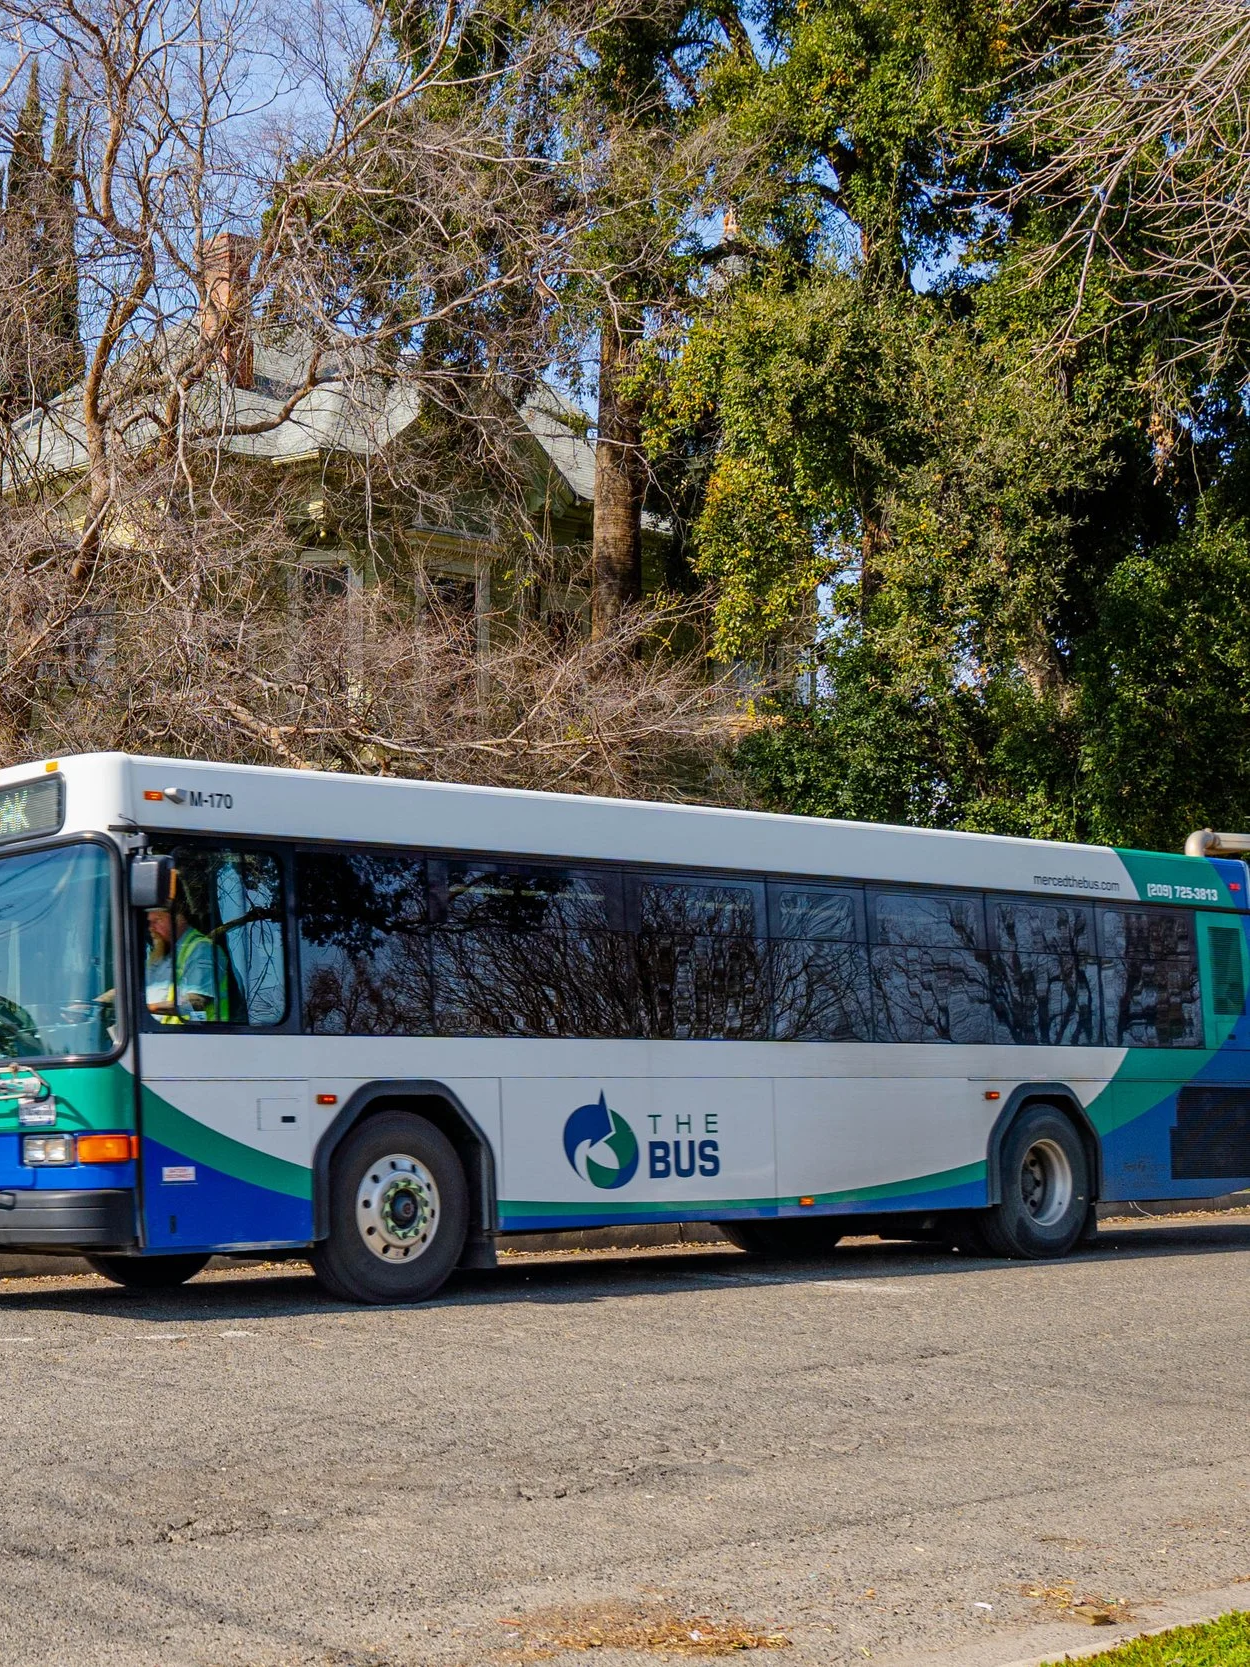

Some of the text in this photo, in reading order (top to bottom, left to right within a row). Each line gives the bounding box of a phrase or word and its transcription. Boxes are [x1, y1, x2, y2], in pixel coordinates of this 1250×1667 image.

[190, 790, 233, 809] M-170
[1033, 874, 1120, 892] mercedthebus.com
[1147, 883, 1218, 901] (209) 725-3813
[647, 1113, 719, 1134] THE
[649, 1139, 720, 1179] BUS
